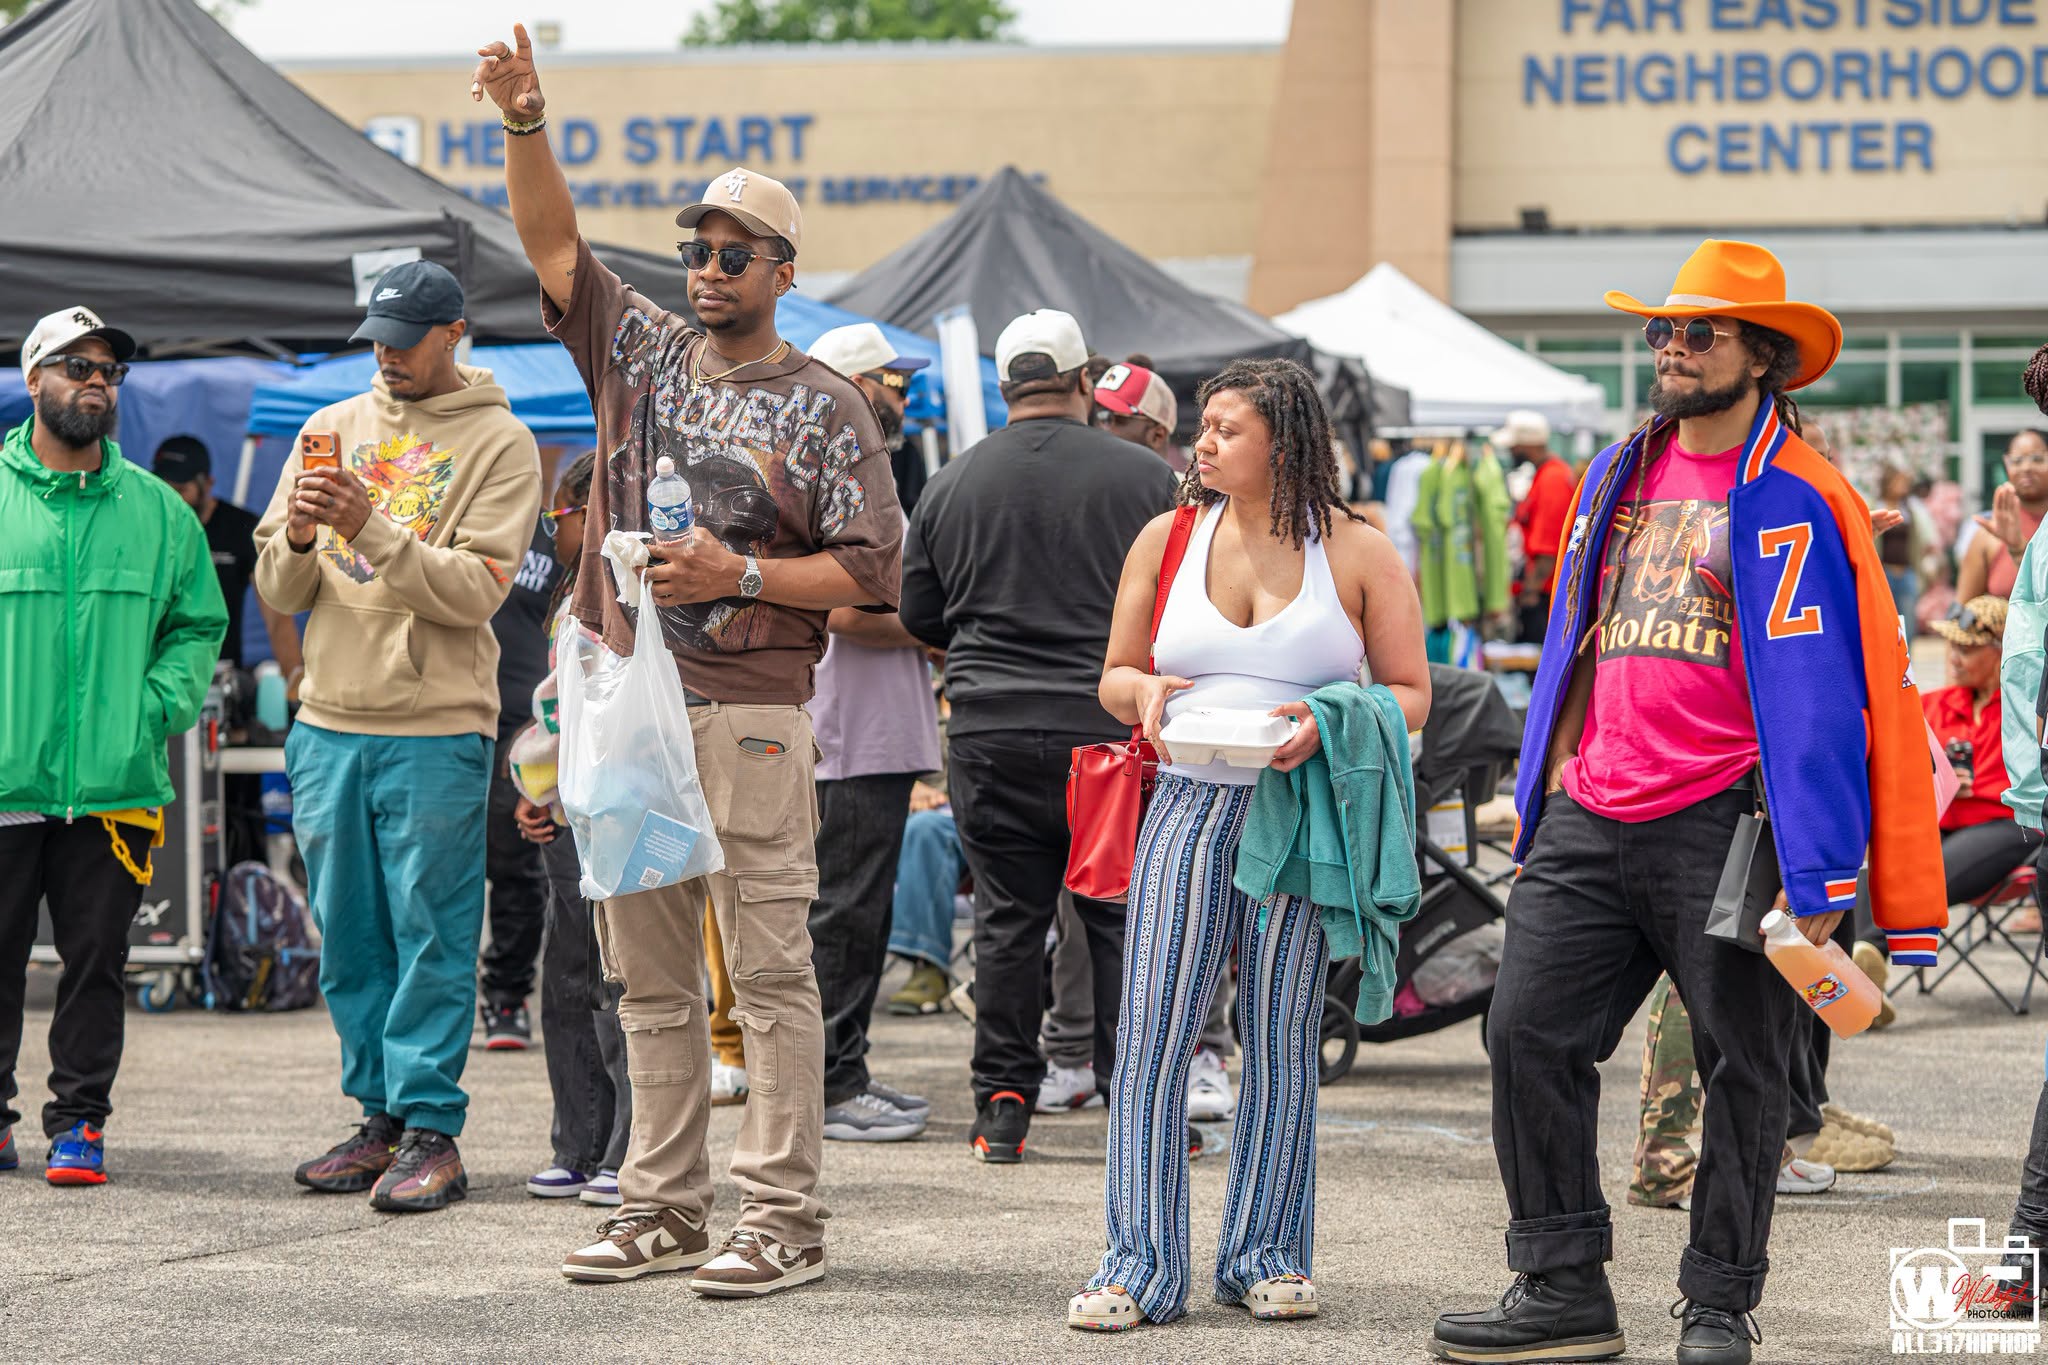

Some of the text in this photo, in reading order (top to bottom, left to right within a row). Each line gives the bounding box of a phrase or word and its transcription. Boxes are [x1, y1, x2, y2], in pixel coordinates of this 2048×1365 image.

[1560, 0, 2037, 33] FAR EASTSIDE
[437, 113, 815, 167] HED START
[1667, 121, 1935, 174] CENTER
[1757, 521, 1824, 641] Z
[1687, 596, 1733, 625] ZELL
